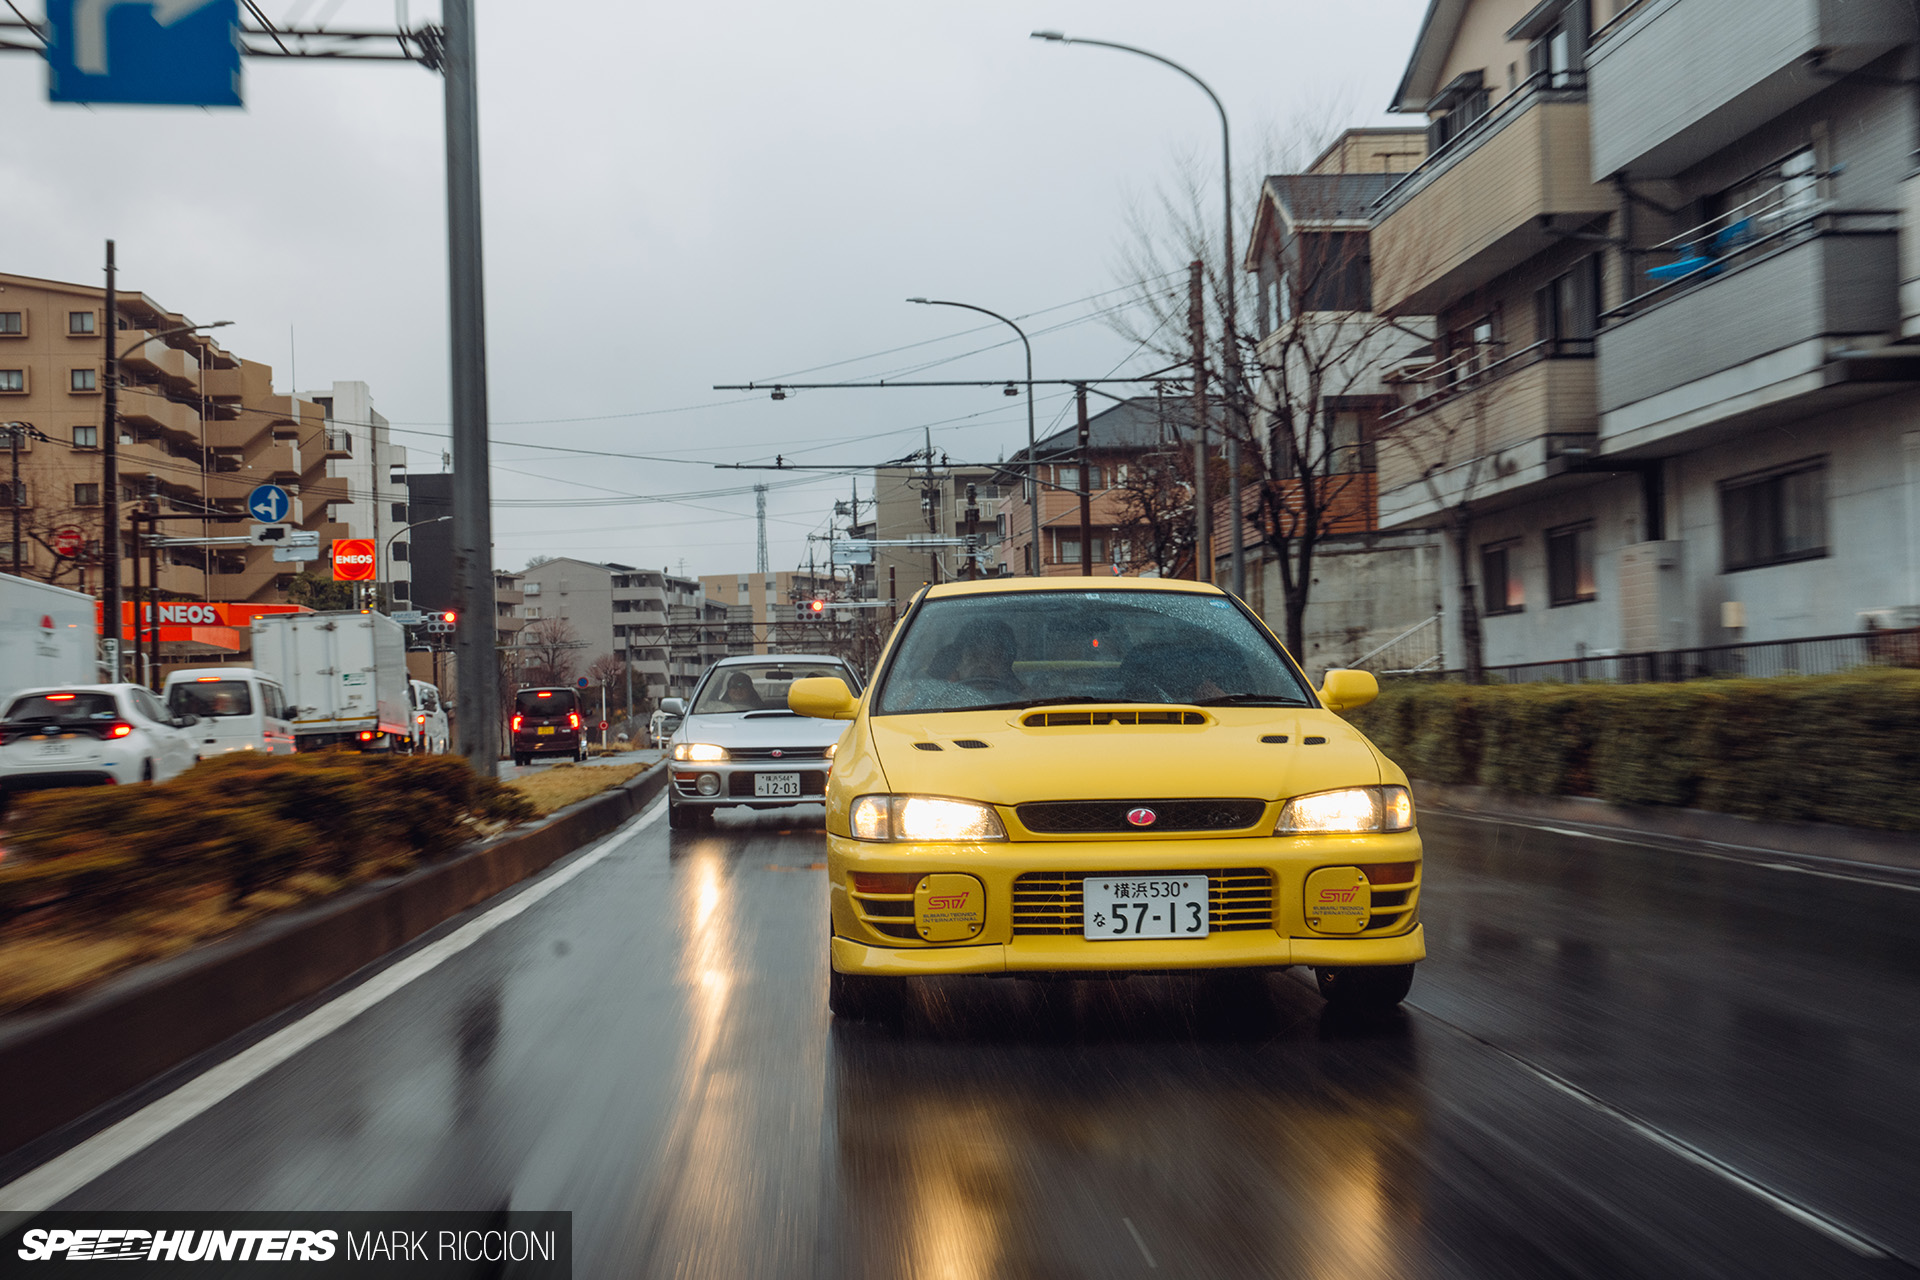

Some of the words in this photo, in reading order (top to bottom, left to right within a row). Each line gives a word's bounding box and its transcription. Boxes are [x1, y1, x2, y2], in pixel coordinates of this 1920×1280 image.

[335, 555, 373, 564] ENEOS
[766, 782, 798, 794] 12-03
[1114, 881, 1180, 899] 横浜530
[1093, 911, 1106, 928] な
[1112, 901, 1202, 934] 57-13
